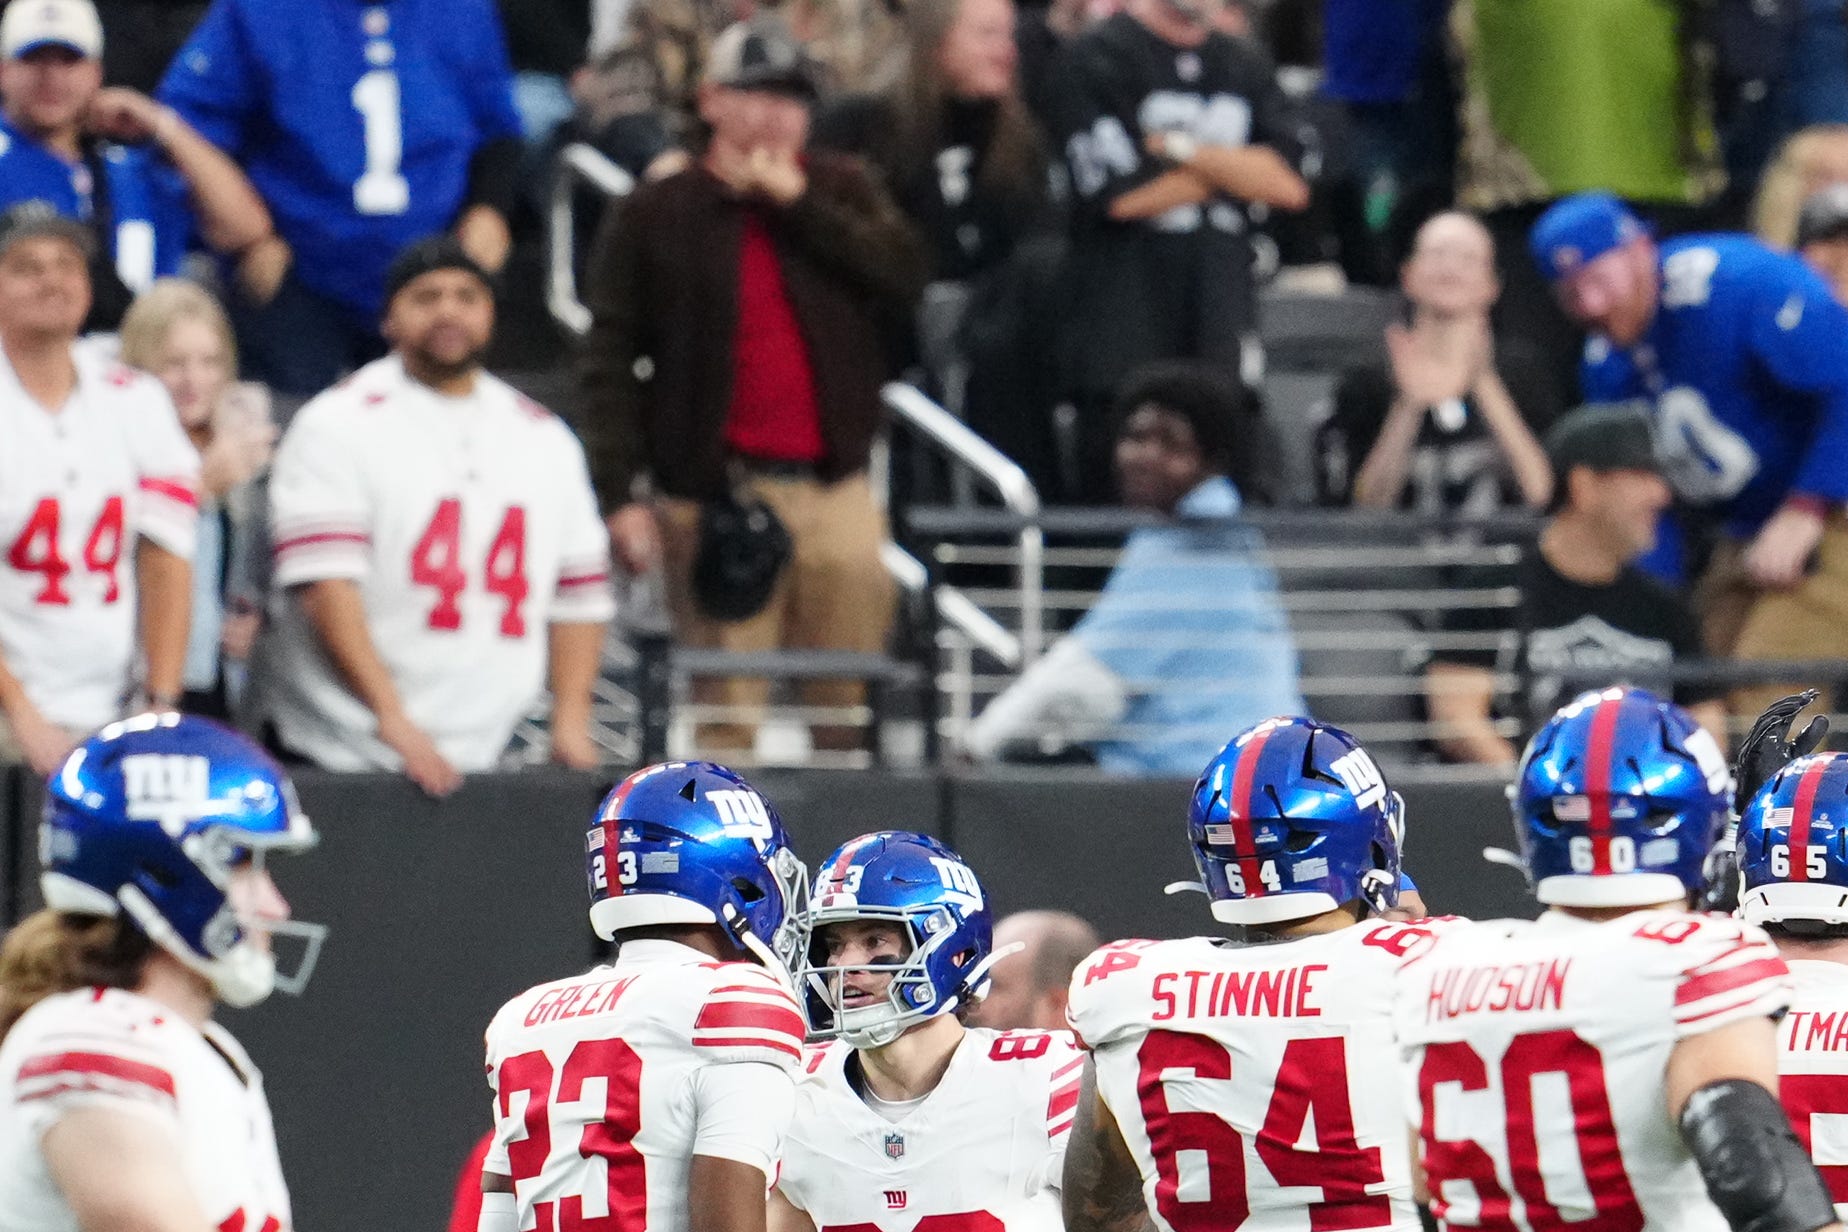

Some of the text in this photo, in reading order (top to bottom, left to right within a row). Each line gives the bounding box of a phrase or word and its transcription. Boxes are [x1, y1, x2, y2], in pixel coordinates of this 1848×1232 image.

[352, 69, 409, 214] 1
[9, 496, 124, 605] 44
[410, 497, 529, 639] 44
[593, 851, 638, 889] 23
[1225, 860, 1282, 894] 64
[1568, 836, 1635, 873] 60
[1771, 845, 1827, 878] 65
[525, 975, 639, 1027] GREEN
[1152, 965, 1329, 1021] STINNIE
[1426, 957, 1572, 1024] HUDSON
